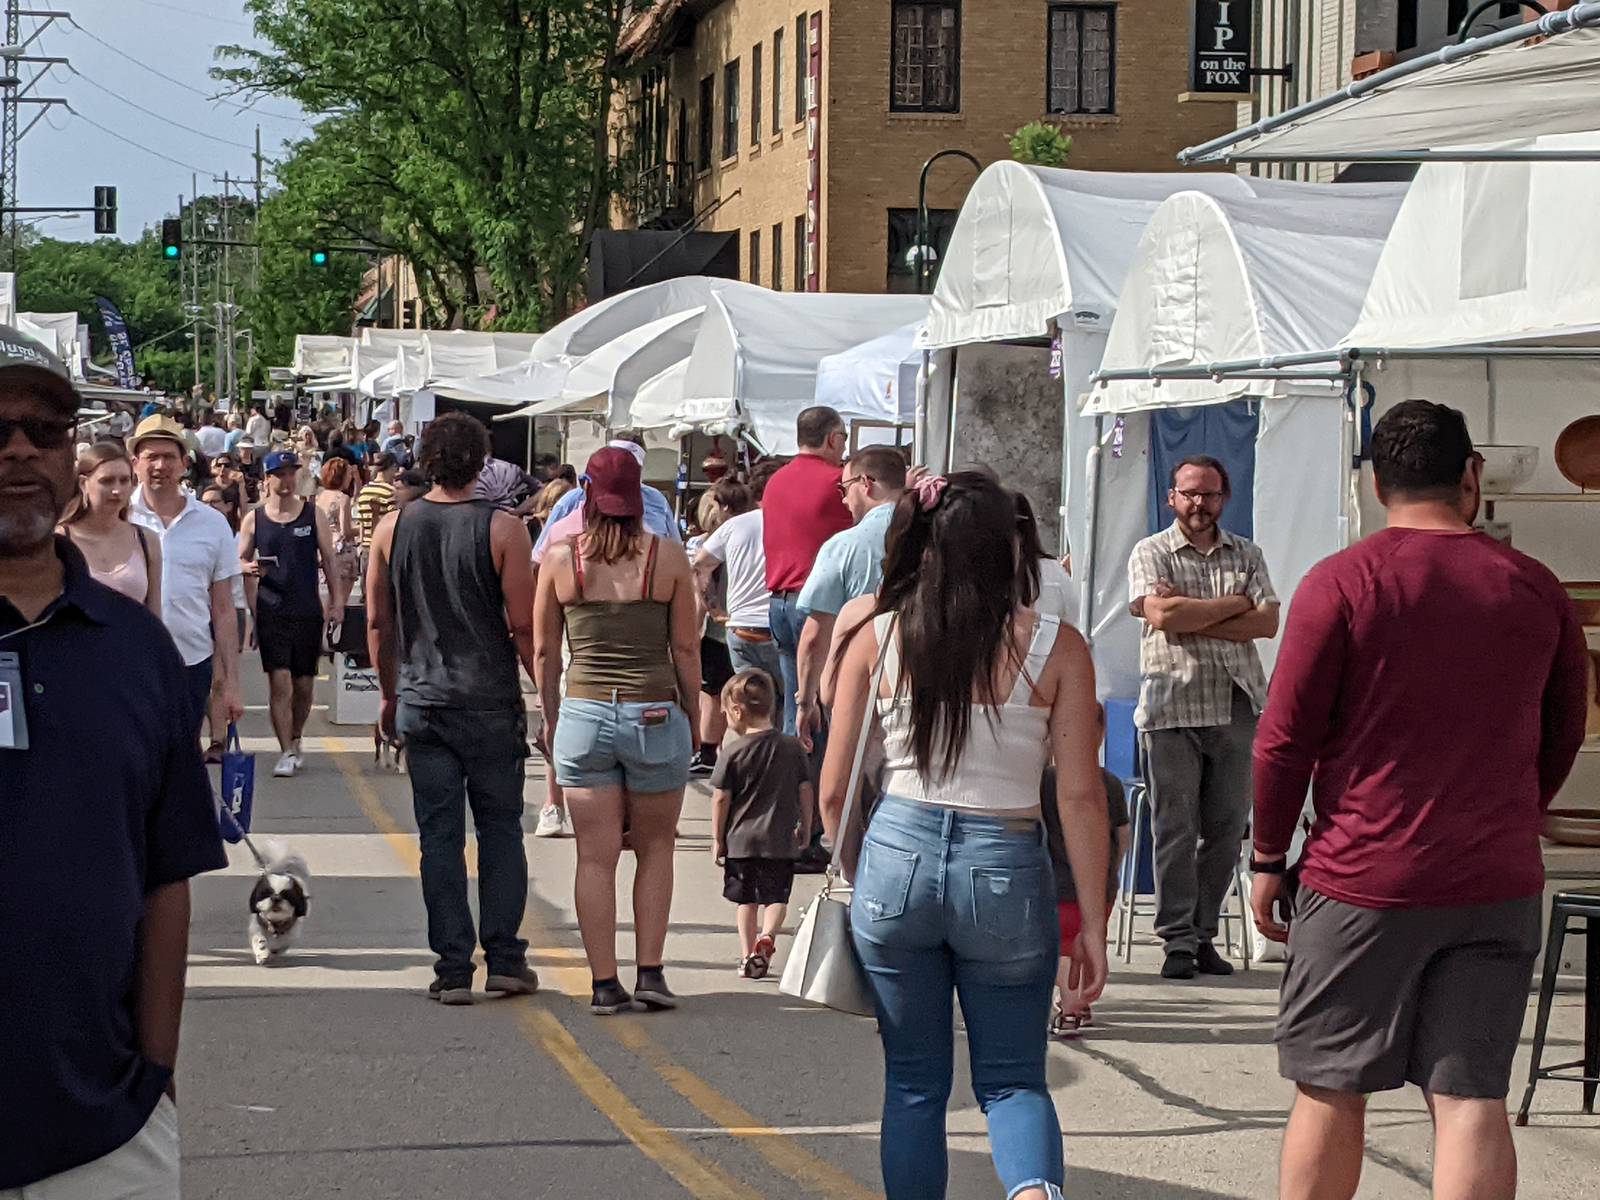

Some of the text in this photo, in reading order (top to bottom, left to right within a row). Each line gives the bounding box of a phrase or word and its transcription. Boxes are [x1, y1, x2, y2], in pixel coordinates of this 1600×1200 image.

[1200, 57, 1246, 71] on the
[1205, 71, 1241, 85] FOX
